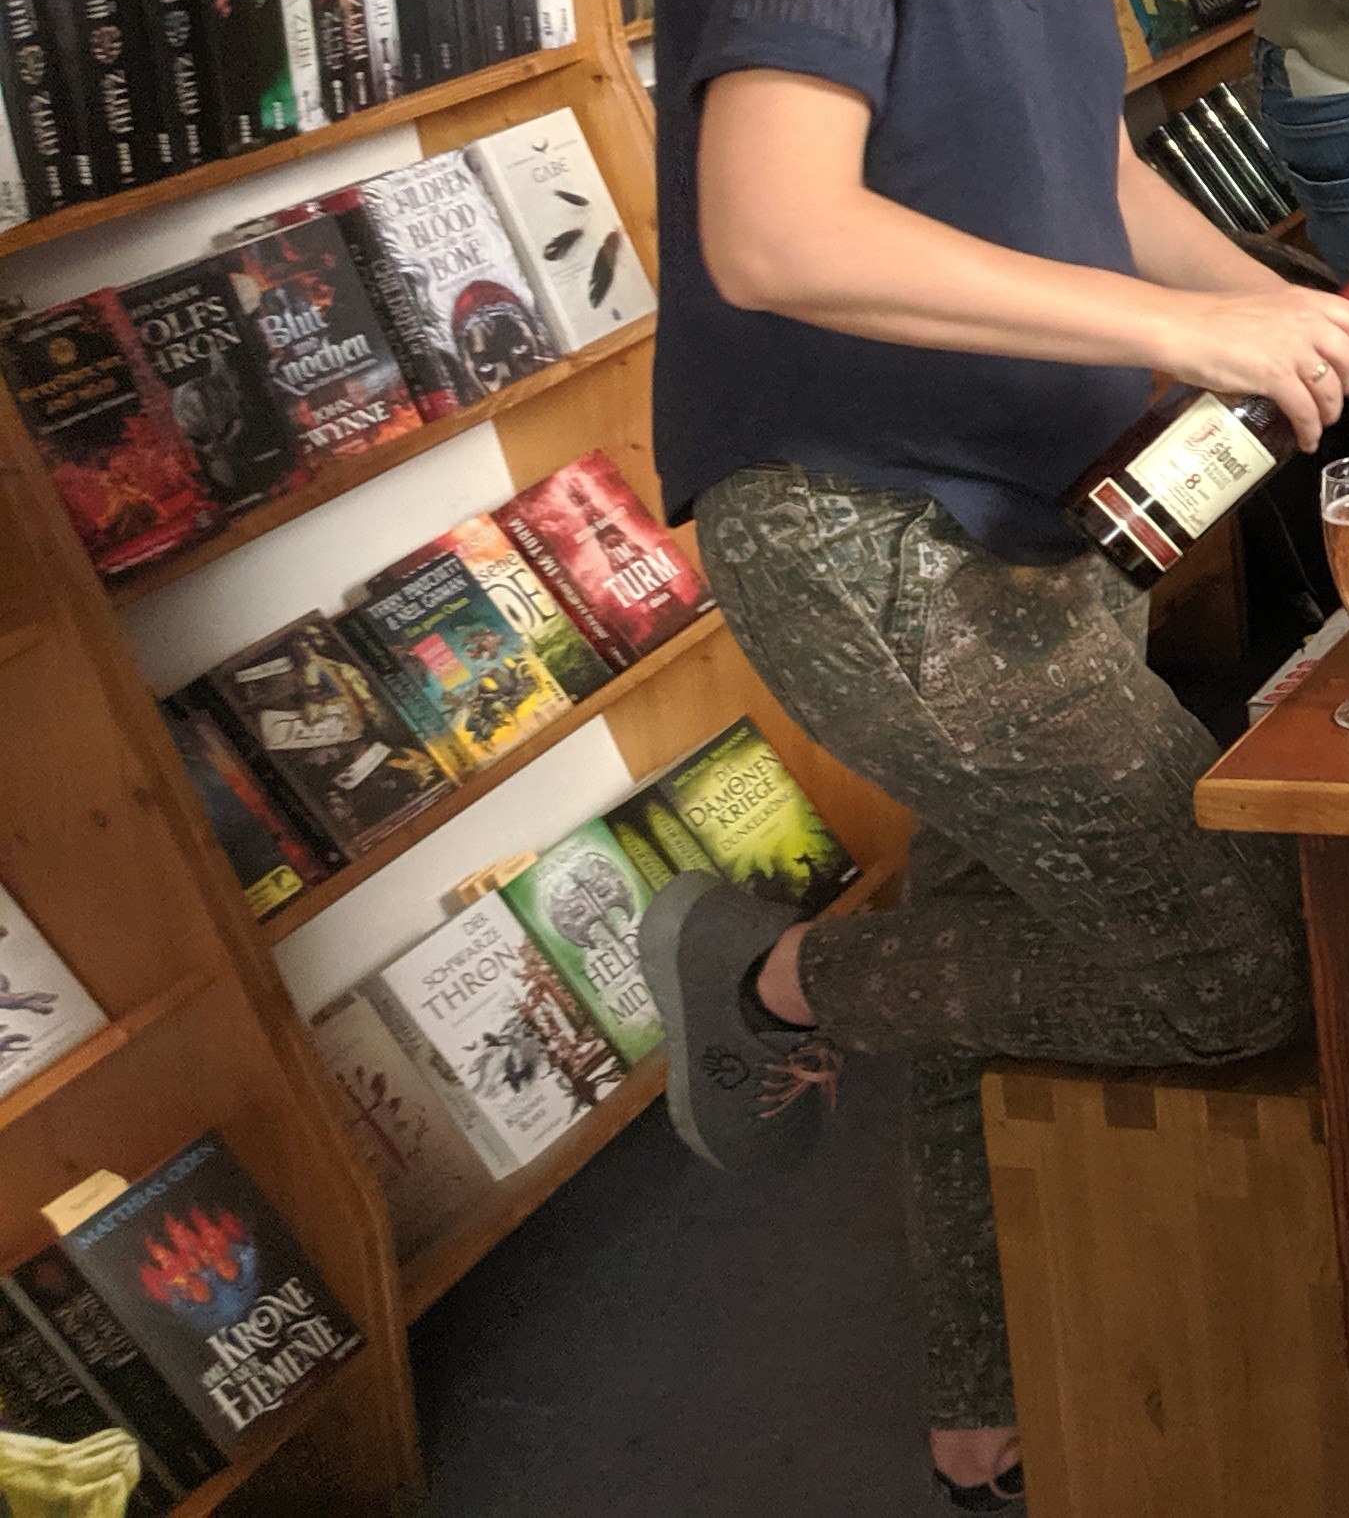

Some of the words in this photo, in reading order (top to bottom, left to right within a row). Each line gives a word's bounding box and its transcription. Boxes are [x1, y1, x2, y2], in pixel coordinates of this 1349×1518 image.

[407, 203, 477, 250] BLOOD
[430, 239, 488, 280] BONE
[259, 305, 329, 349] Blut
[1185, 473, 1201, 490] 8
[603, 547, 682, 608] TURM
[685, 753, 780, 829] DÄMONEN
[716, 777, 777, 830] KRIEGE
[421, 942, 520, 1023] THRON
[202, 1277, 315, 1369] KRONE
[208, 1316, 344, 1431] ELEMENTE
